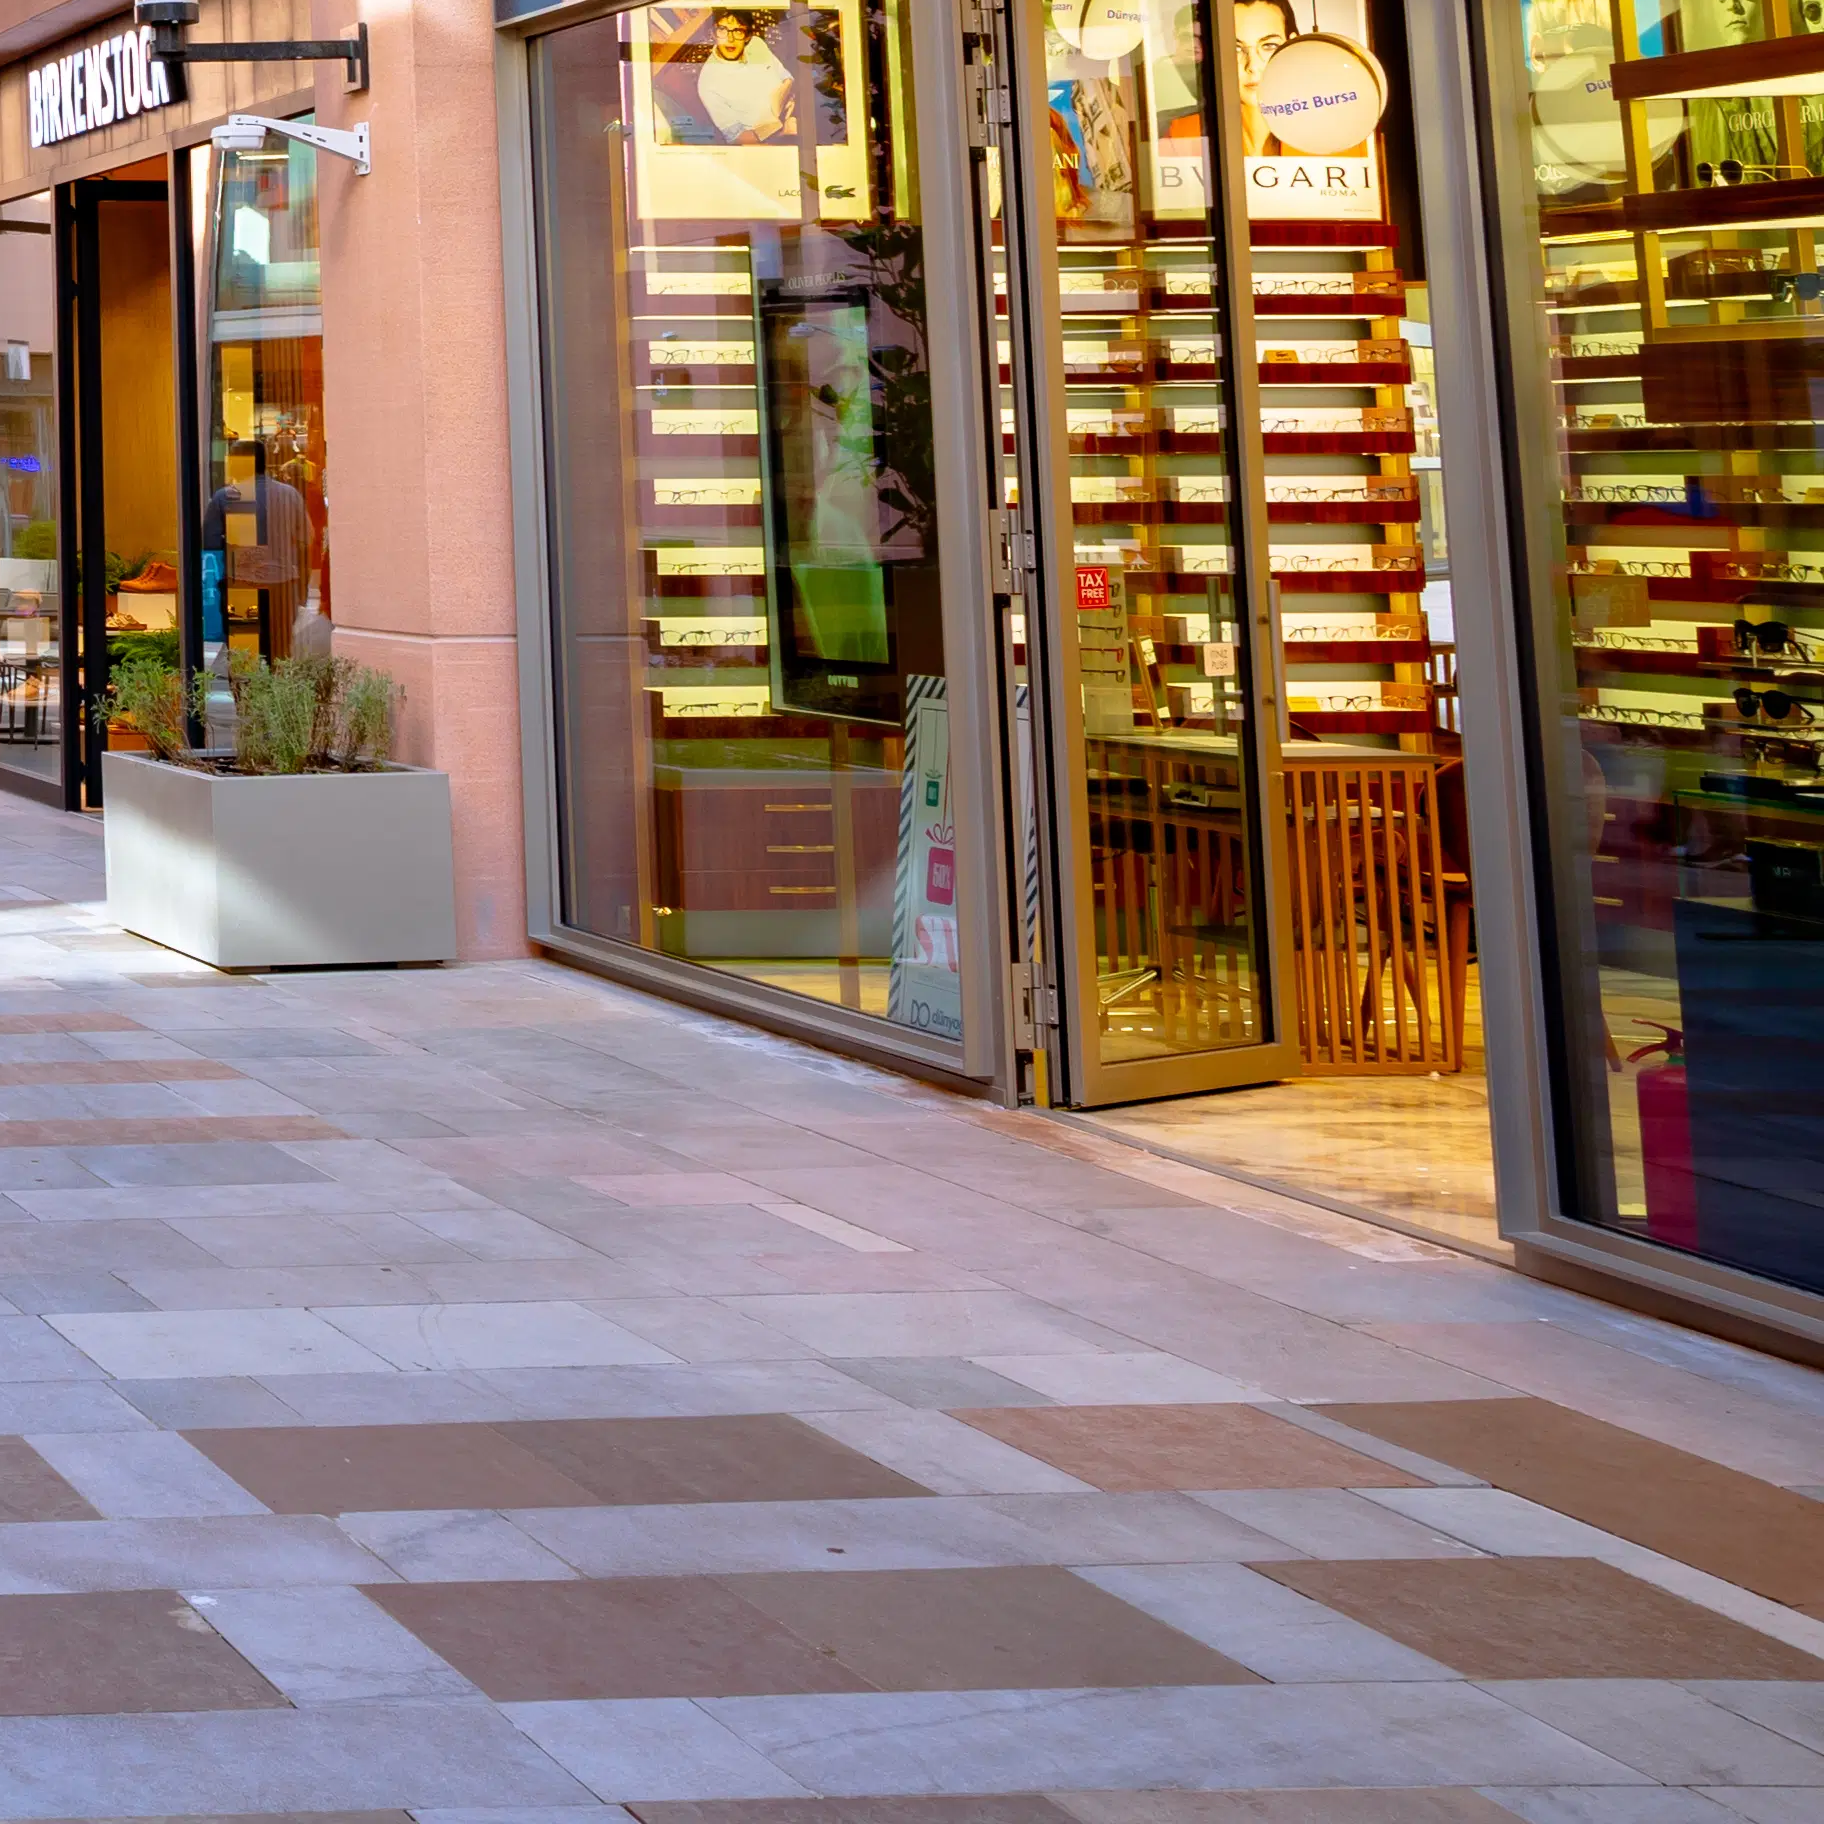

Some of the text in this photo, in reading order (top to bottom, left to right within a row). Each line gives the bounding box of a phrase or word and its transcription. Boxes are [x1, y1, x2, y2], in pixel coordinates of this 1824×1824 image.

[29, 25, 170, 148] BIRKENSTOCK
[1260, 91, 1358, 116] ünyagöz Bursa
[1078, 573, 1105, 588] TAX
[1081, 588, 1105, 600] FREE
